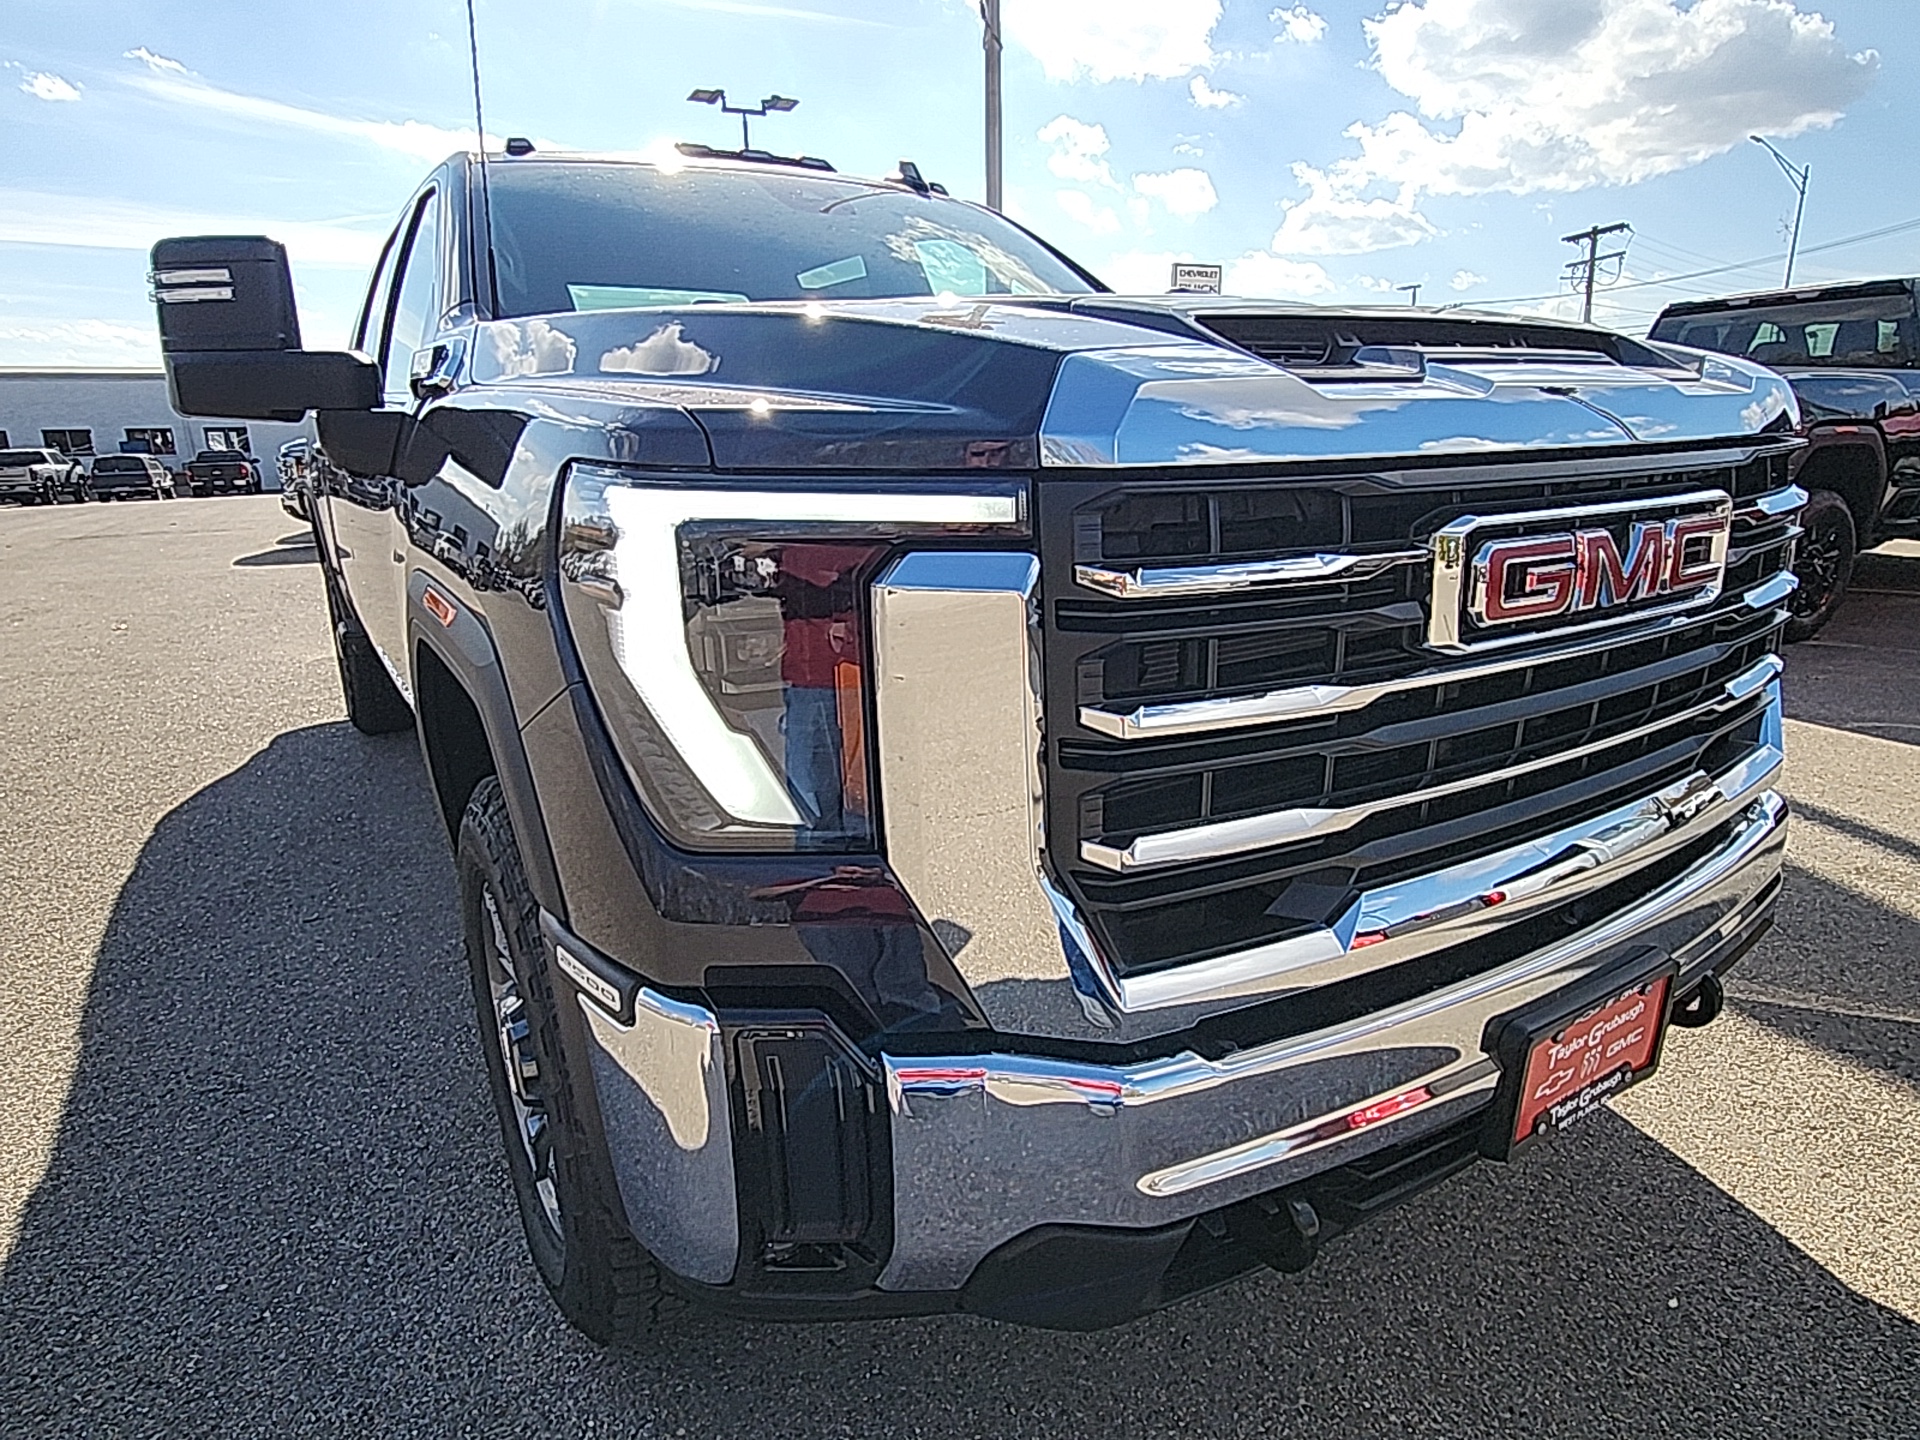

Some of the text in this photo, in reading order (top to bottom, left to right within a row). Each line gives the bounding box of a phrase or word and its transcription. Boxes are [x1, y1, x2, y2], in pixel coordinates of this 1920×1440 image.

[1470, 516, 1728, 626] GMC
[559, 951, 617, 1004] 2500
[1547, 1000, 1645, 1070] Taylor Grubaugh
[1606, 1026, 1645, 1058] GMC
[1550, 1096, 1580, 1126] Taylor
[1579, 1070, 1622, 1106] Grubaugh
